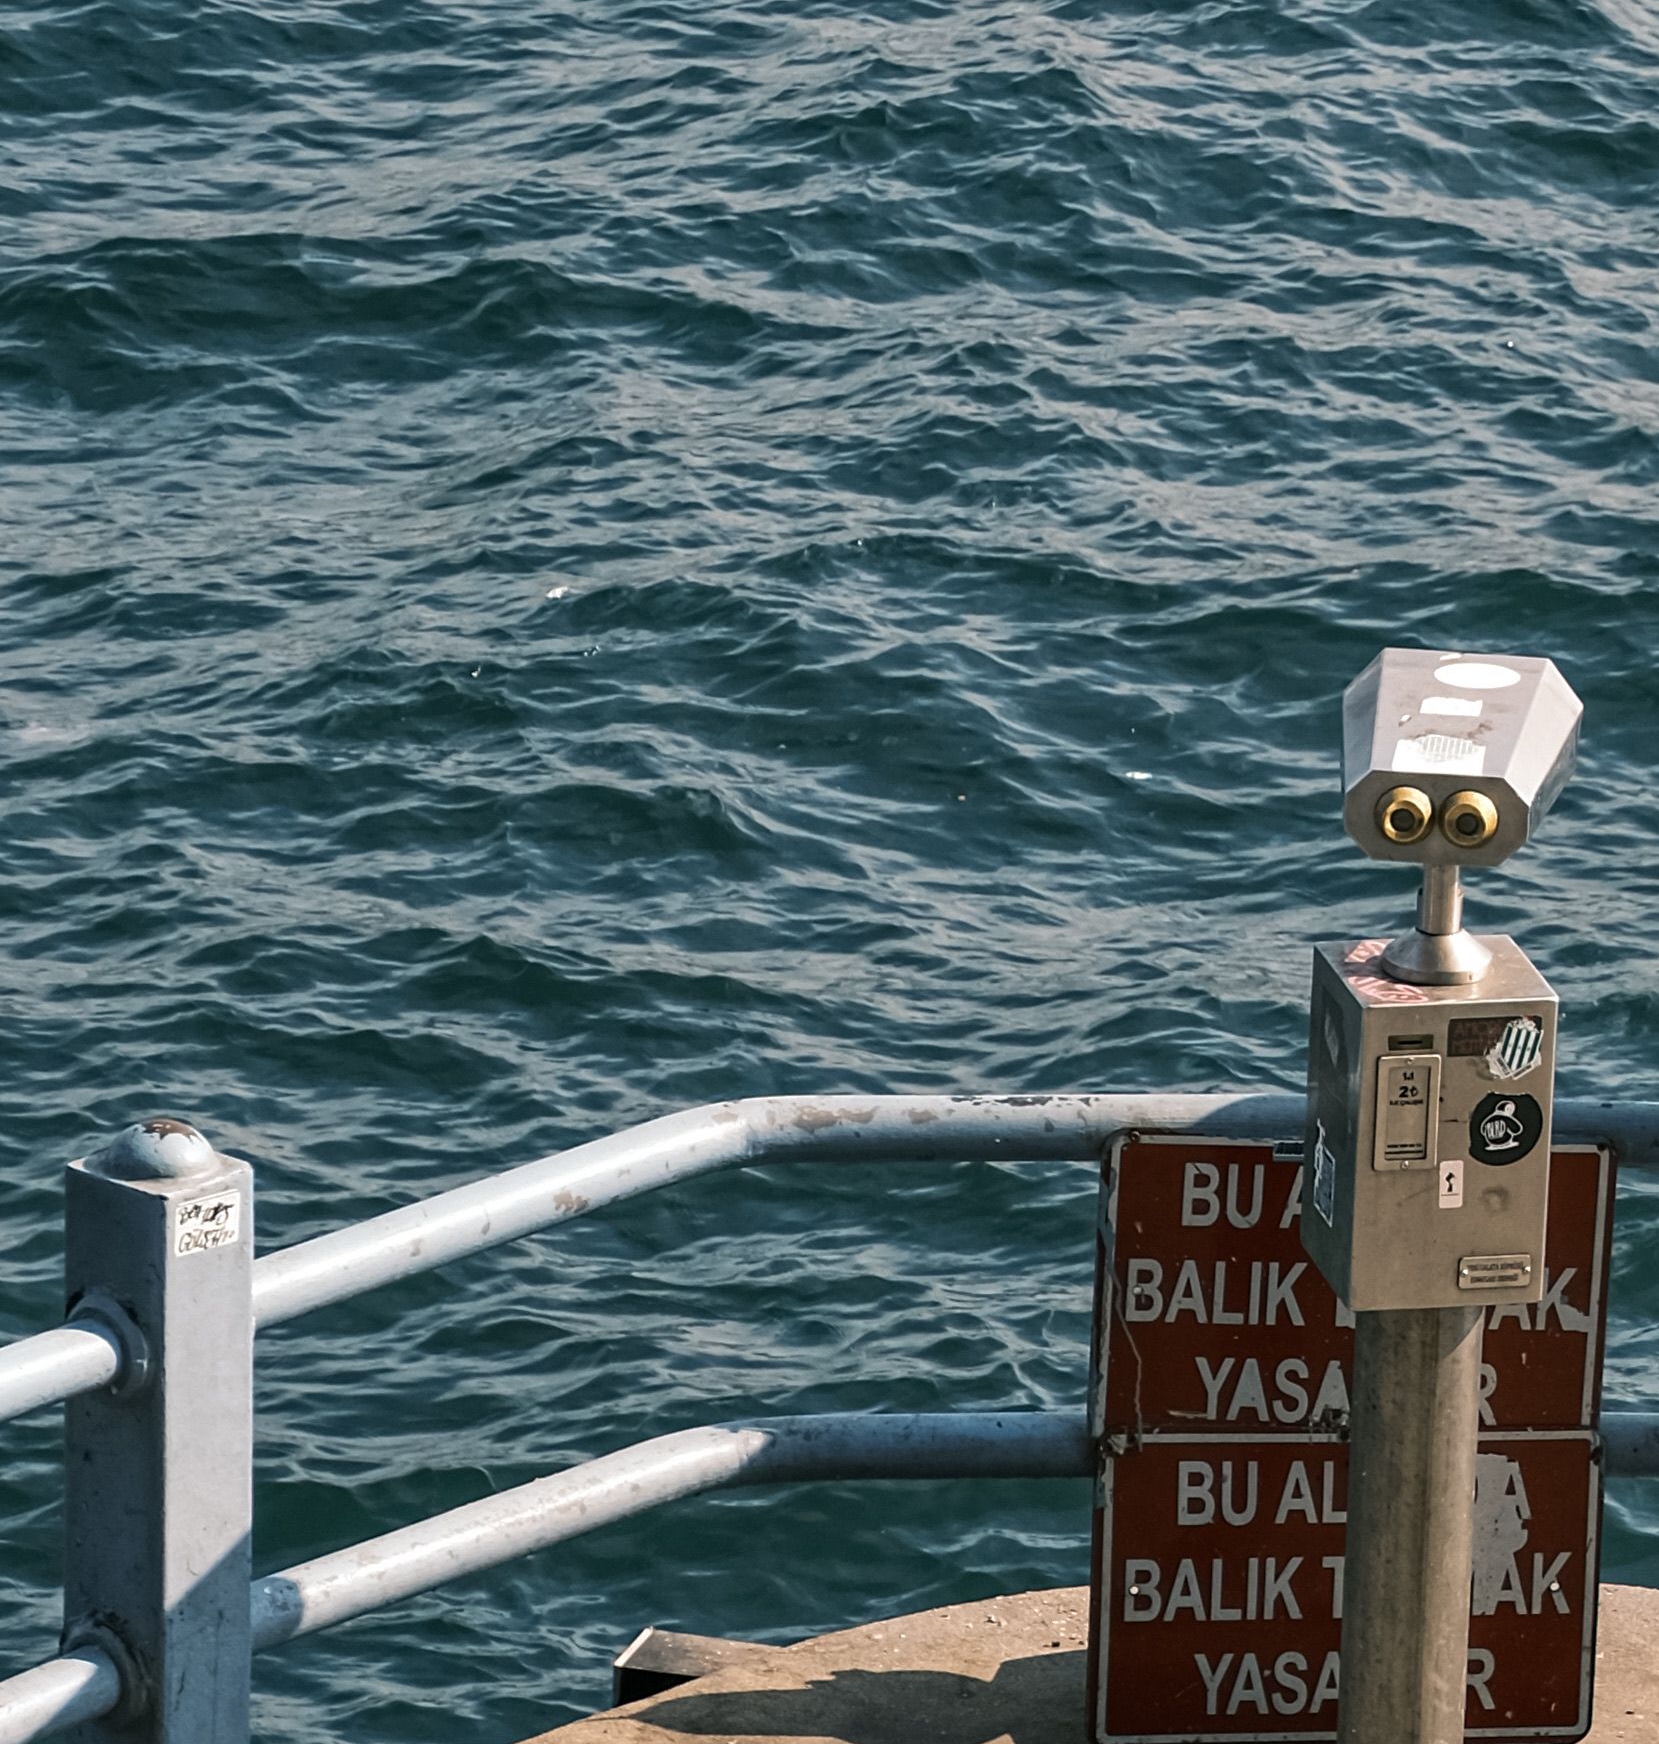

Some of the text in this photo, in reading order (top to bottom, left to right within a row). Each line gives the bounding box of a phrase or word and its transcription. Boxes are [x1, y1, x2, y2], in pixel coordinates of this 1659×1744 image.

[1181, 1161, 1265, 1229] BU
[1124, 1257, 1308, 1327] BALIK
[1177, 1460, 1259, 1526] BU
[1123, 1556, 1304, 1623] BALIK
